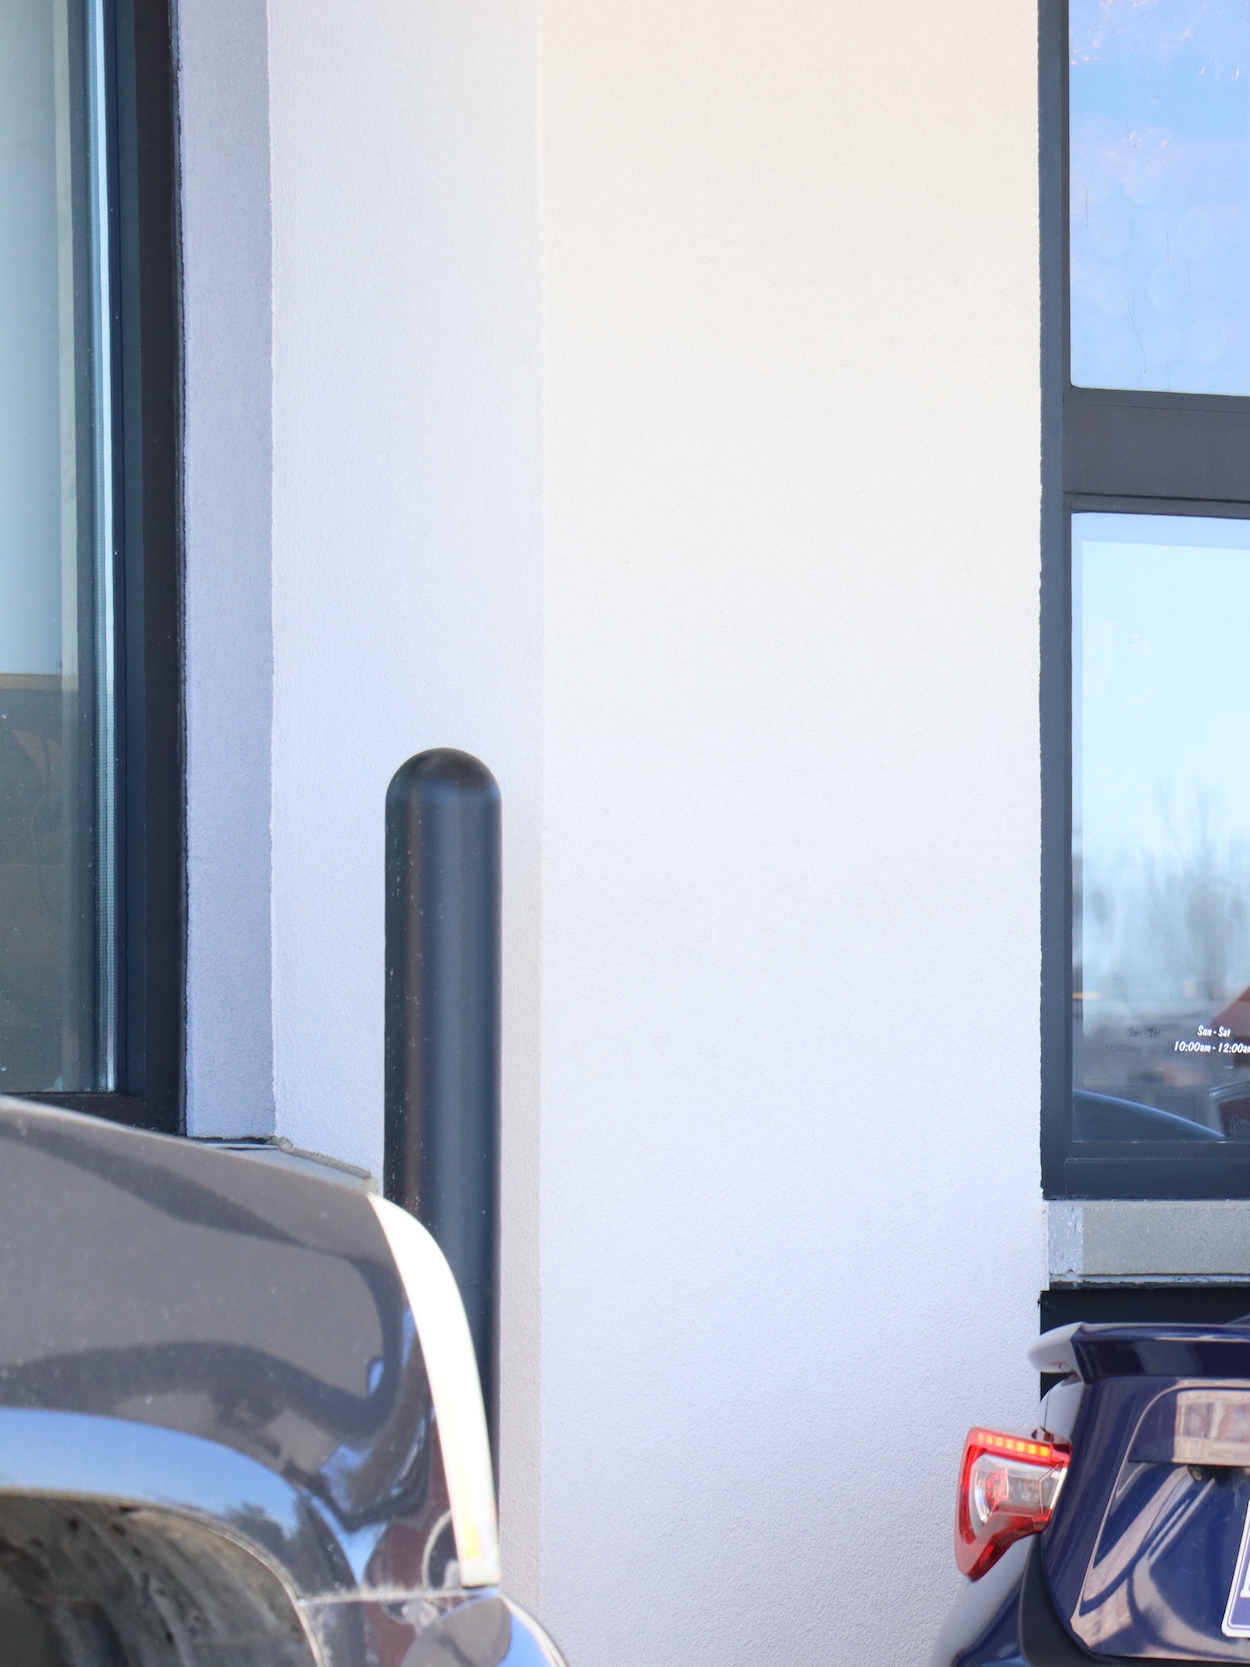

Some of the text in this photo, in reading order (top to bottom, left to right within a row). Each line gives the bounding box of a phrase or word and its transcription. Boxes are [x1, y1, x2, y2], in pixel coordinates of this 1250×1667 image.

[1197, 1024, 1212, 1037] Sun
[1218, 1026, 1231, 1038] Sat
[1174, 1040, 1211, 1052] 10:00am
